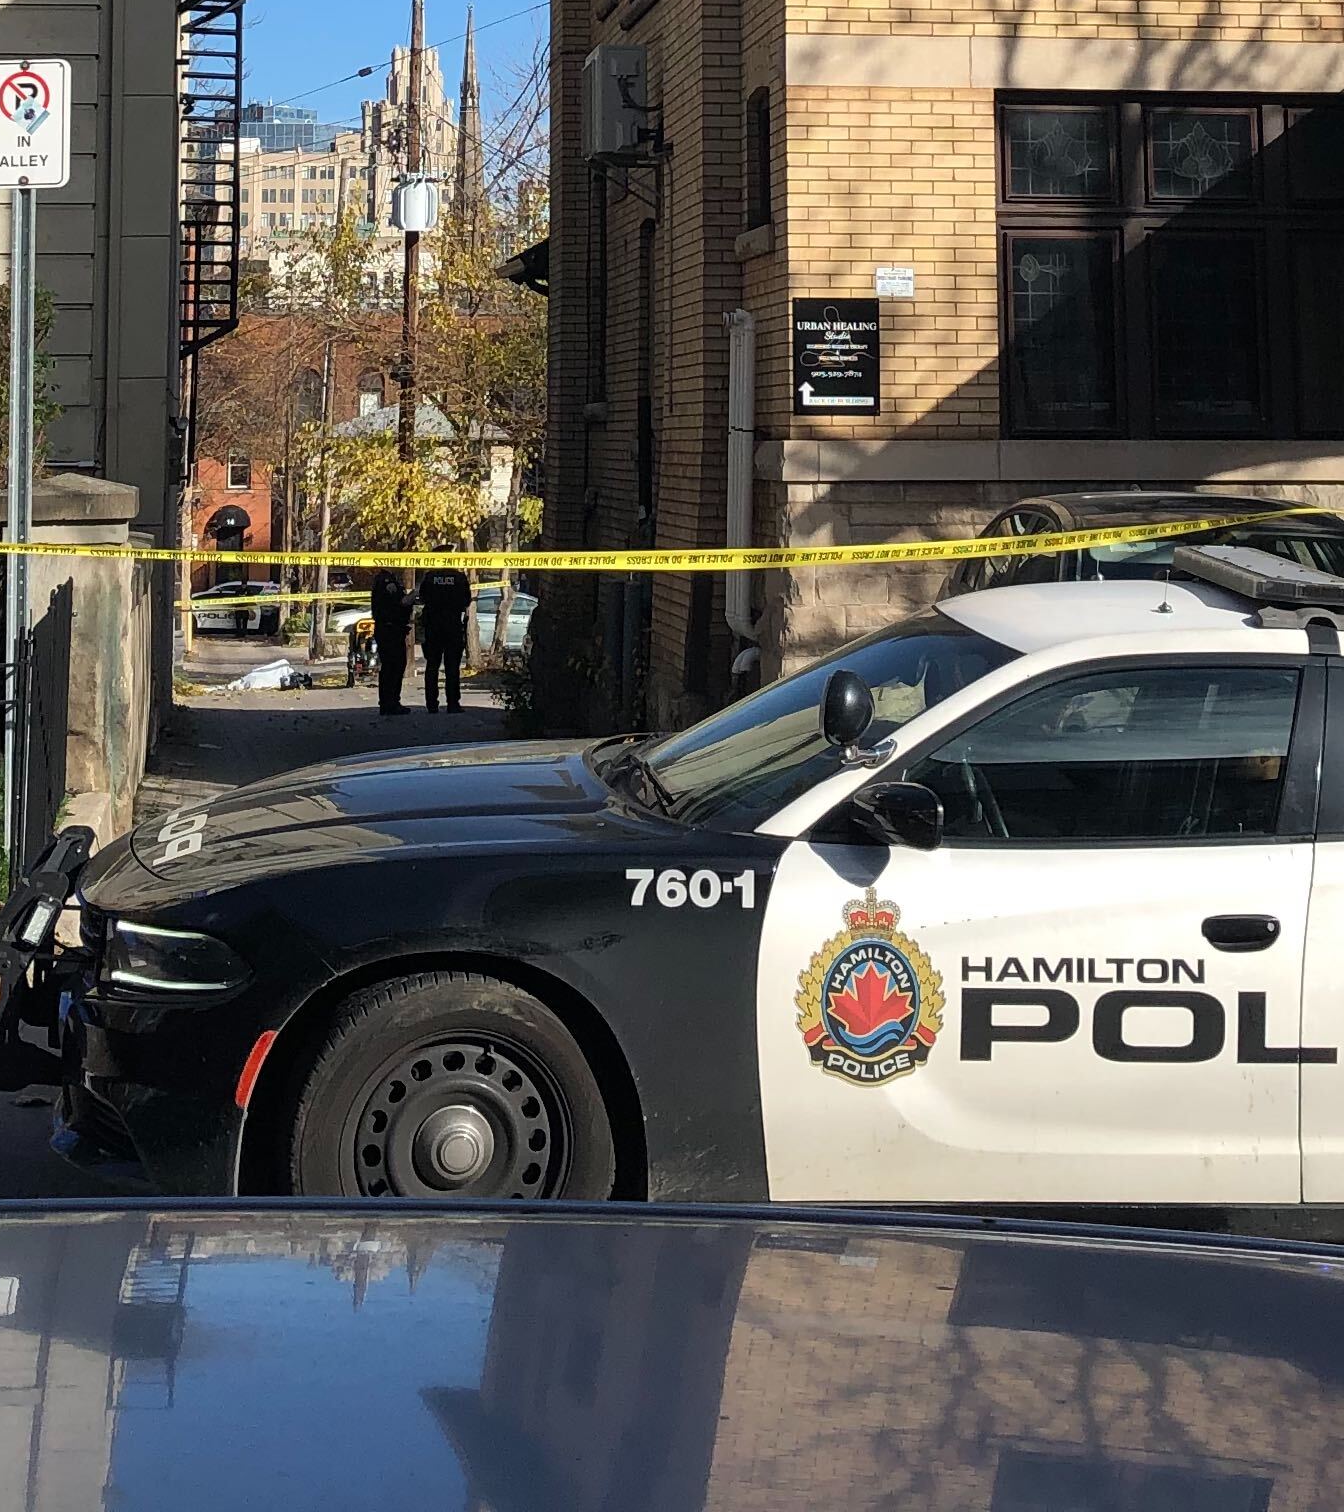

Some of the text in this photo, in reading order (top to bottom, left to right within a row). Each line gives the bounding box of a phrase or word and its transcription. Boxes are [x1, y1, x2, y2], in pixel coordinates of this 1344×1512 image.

[17, 136, 31, 147] IN
[0, 155, 49, 168] ALLEY
[797, 322, 877, 331] URBAN HEALING
[743, 552, 844, 563] POLICE LINE DO NOT CROSS
[852, 547, 945, 560] POLICE LINE DO NOT CROSS
[373, 557, 493, 566] POLICE LINE DO NOT CROSS
[504, 556, 616, 566] POLICE LINE DO NOT CROSS
[626, 554, 734, 565] POLICE LINE DO NOT CROSS
[831, 947, 911, 989] HAMILTON
[961, 956, 1205, 984] HAMILTON
[827, 1053, 911, 1079] POLICE
